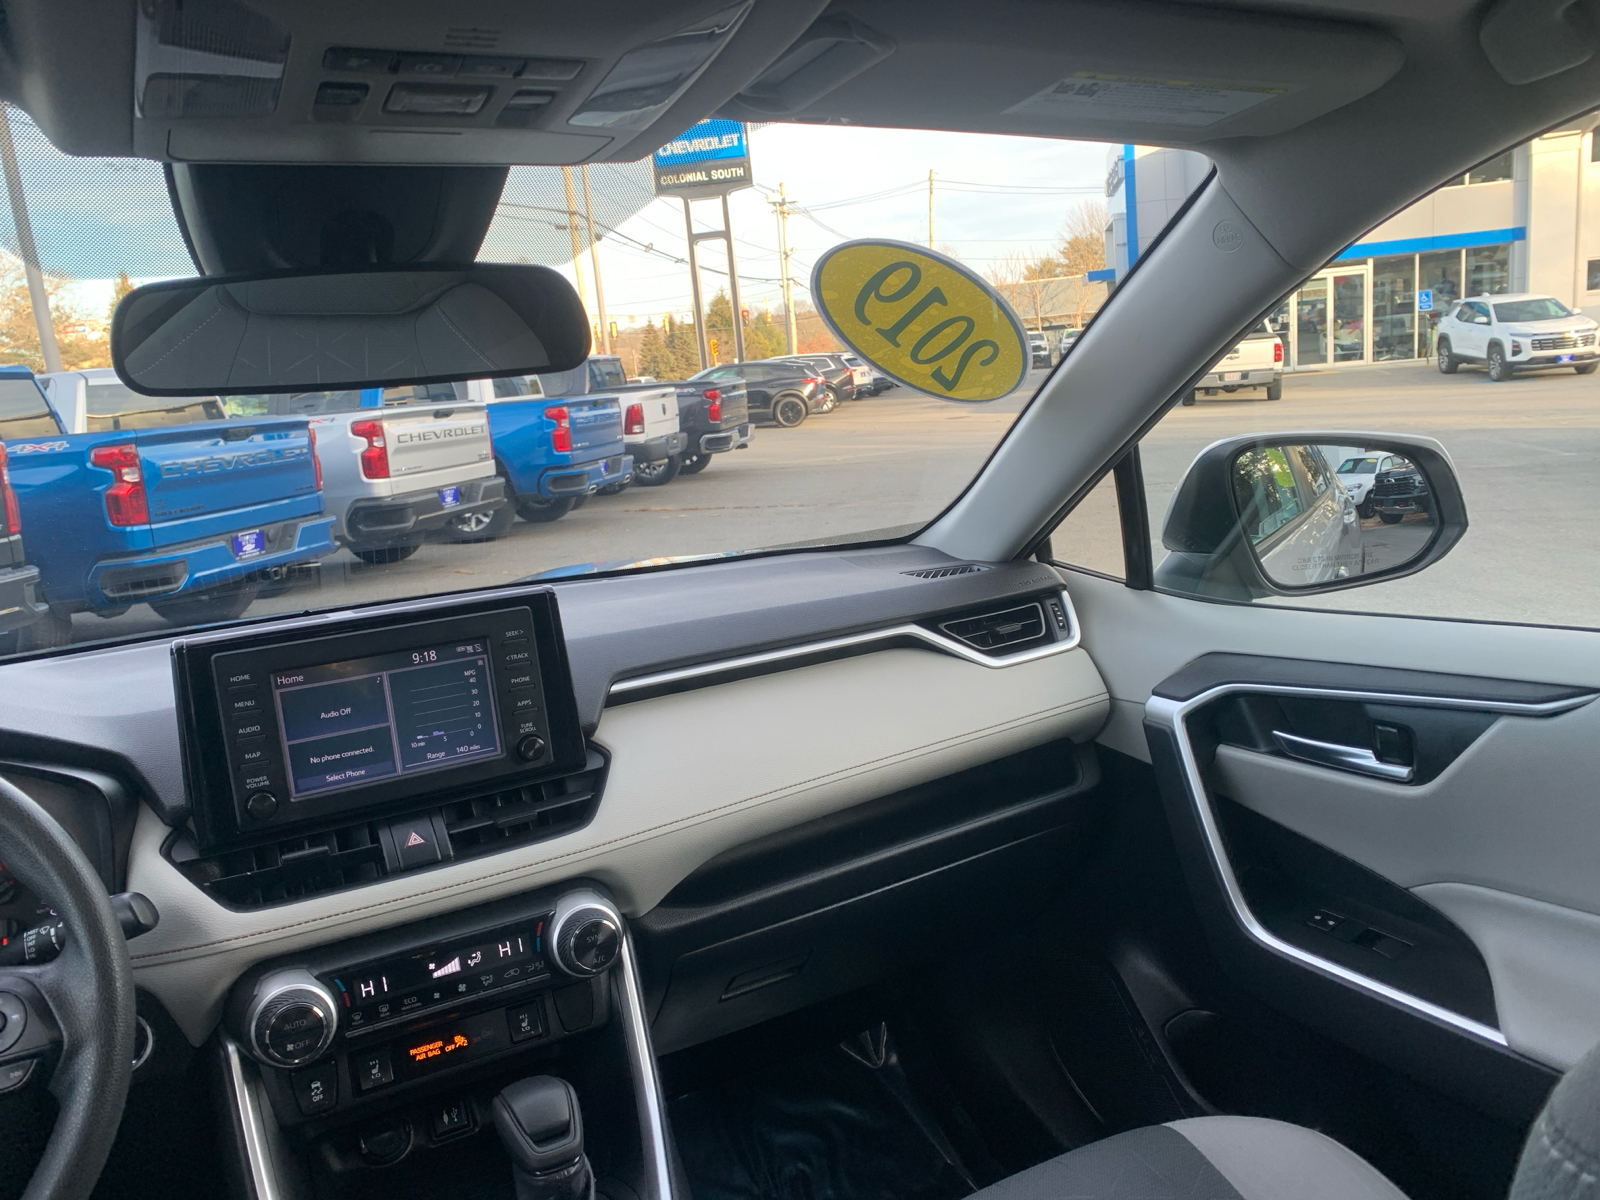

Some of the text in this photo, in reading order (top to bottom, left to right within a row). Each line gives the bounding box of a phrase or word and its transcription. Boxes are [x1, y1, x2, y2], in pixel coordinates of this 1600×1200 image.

[658, 133, 740, 156] CHEVROLET
[660, 167, 744, 185] COLONIAL SOUTH
[397, 424, 485, 444] CHEVROLET
[161, 447, 309, 478] CHEVROLET
[1297, 555, 1325, 564] OBJECTS
[1292, 562, 1317, 571] CLOSER
[412, 650, 437, 664] 9:18
[230, 674, 251, 683] HOME
[277, 674, 304, 685] Home
[511, 676, 530, 684] PHONE
[234, 700, 255, 709] MENU
[320, 707, 351, 719] Audio Off
[238, 725, 261, 735] AUDIO
[245, 751, 261, 760] MAP
[321, 753, 341, 763] phone
[341, 746, 375, 758] connected.
[427, 751, 446, 759] Range
[456, 745, 469, 753] 140
[246, 776, 268, 784] POWER
[326, 768, 366, 783] Select Phone
[246, 780, 270, 789] VOLUME
[586, 933, 603, 943] SYNC
[498, 938, 523, 958] HI
[592, 955, 606, 964] A/C
[361, 976, 388, 998] HI
[404, 996, 417, 1004] ECO
[284, 1019, 307, 1031] AUTO
[294, 1039, 310, 1049] OFF
[409, 1040, 443, 1056] PASSENGER
[416, 1043, 456, 1061] AIR BAG OFF
[312, 1094, 324, 1102] OFF
